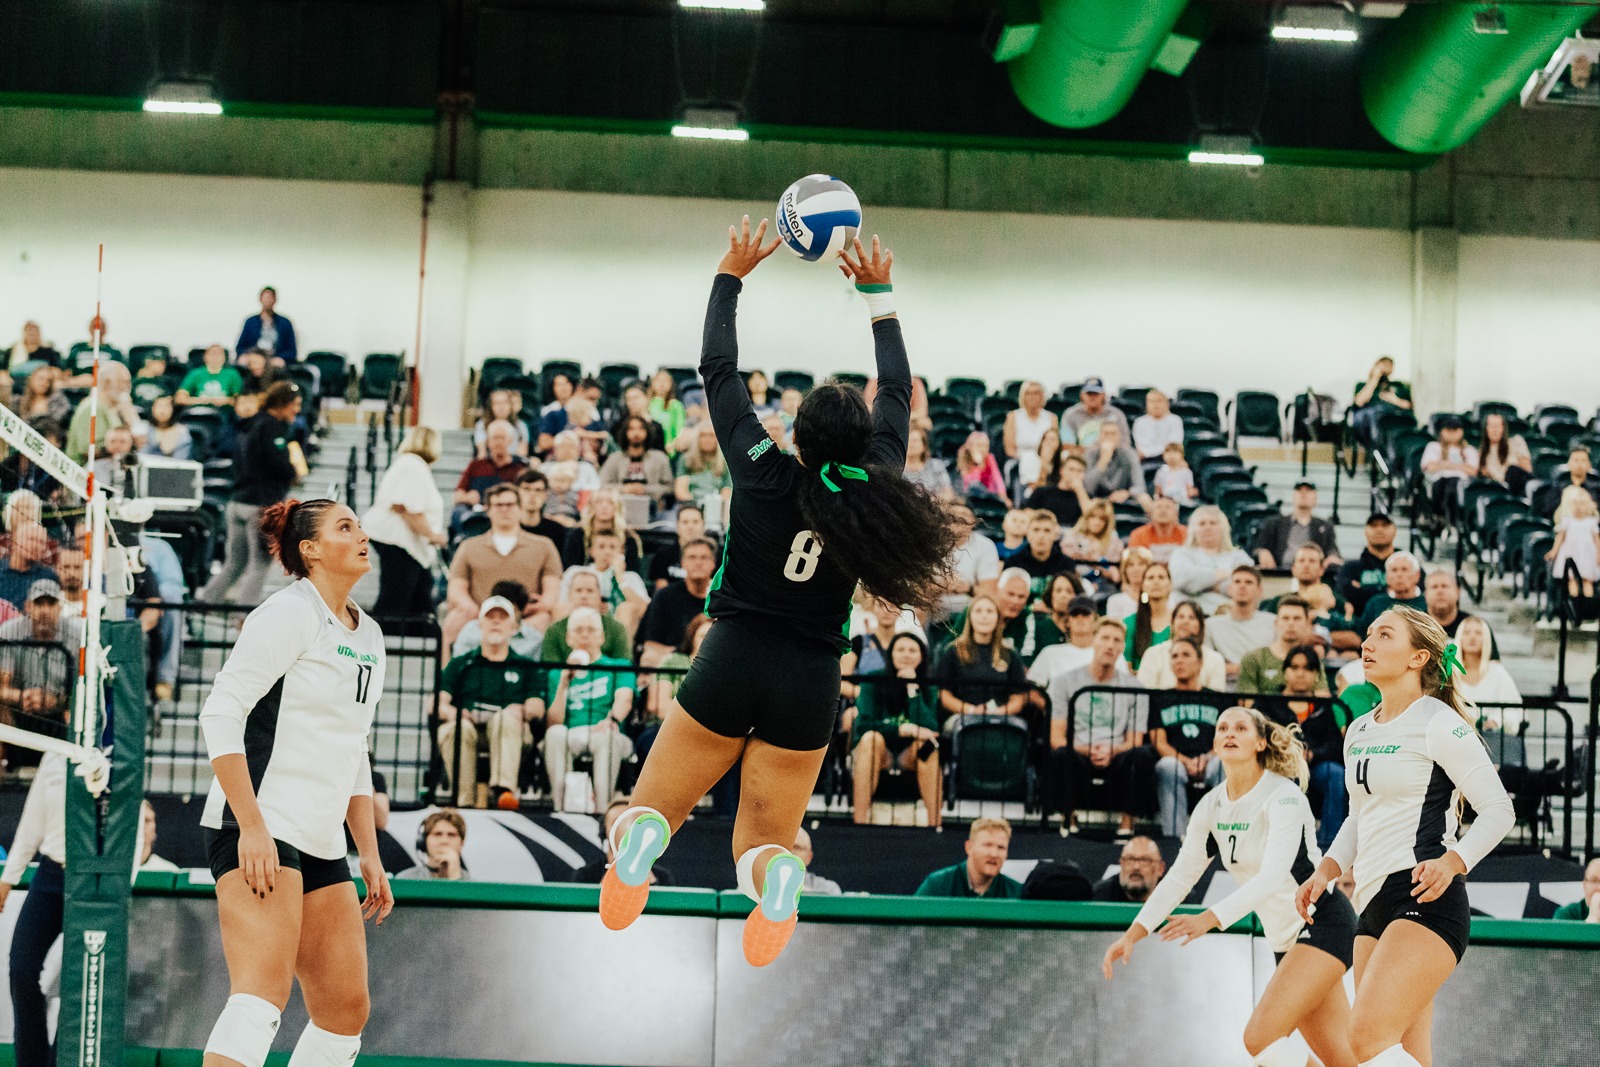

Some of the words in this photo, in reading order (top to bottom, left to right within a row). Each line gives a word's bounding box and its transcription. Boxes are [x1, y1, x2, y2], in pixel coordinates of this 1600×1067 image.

[785, 192, 804, 239] molten
[783, 530, 824, 582] 8
[356, 663, 372, 704] 17
[1365, 745, 1401, 754] VALLEY
[1356, 758, 1372, 794] 4
[1228, 834, 1238, 864] 2
